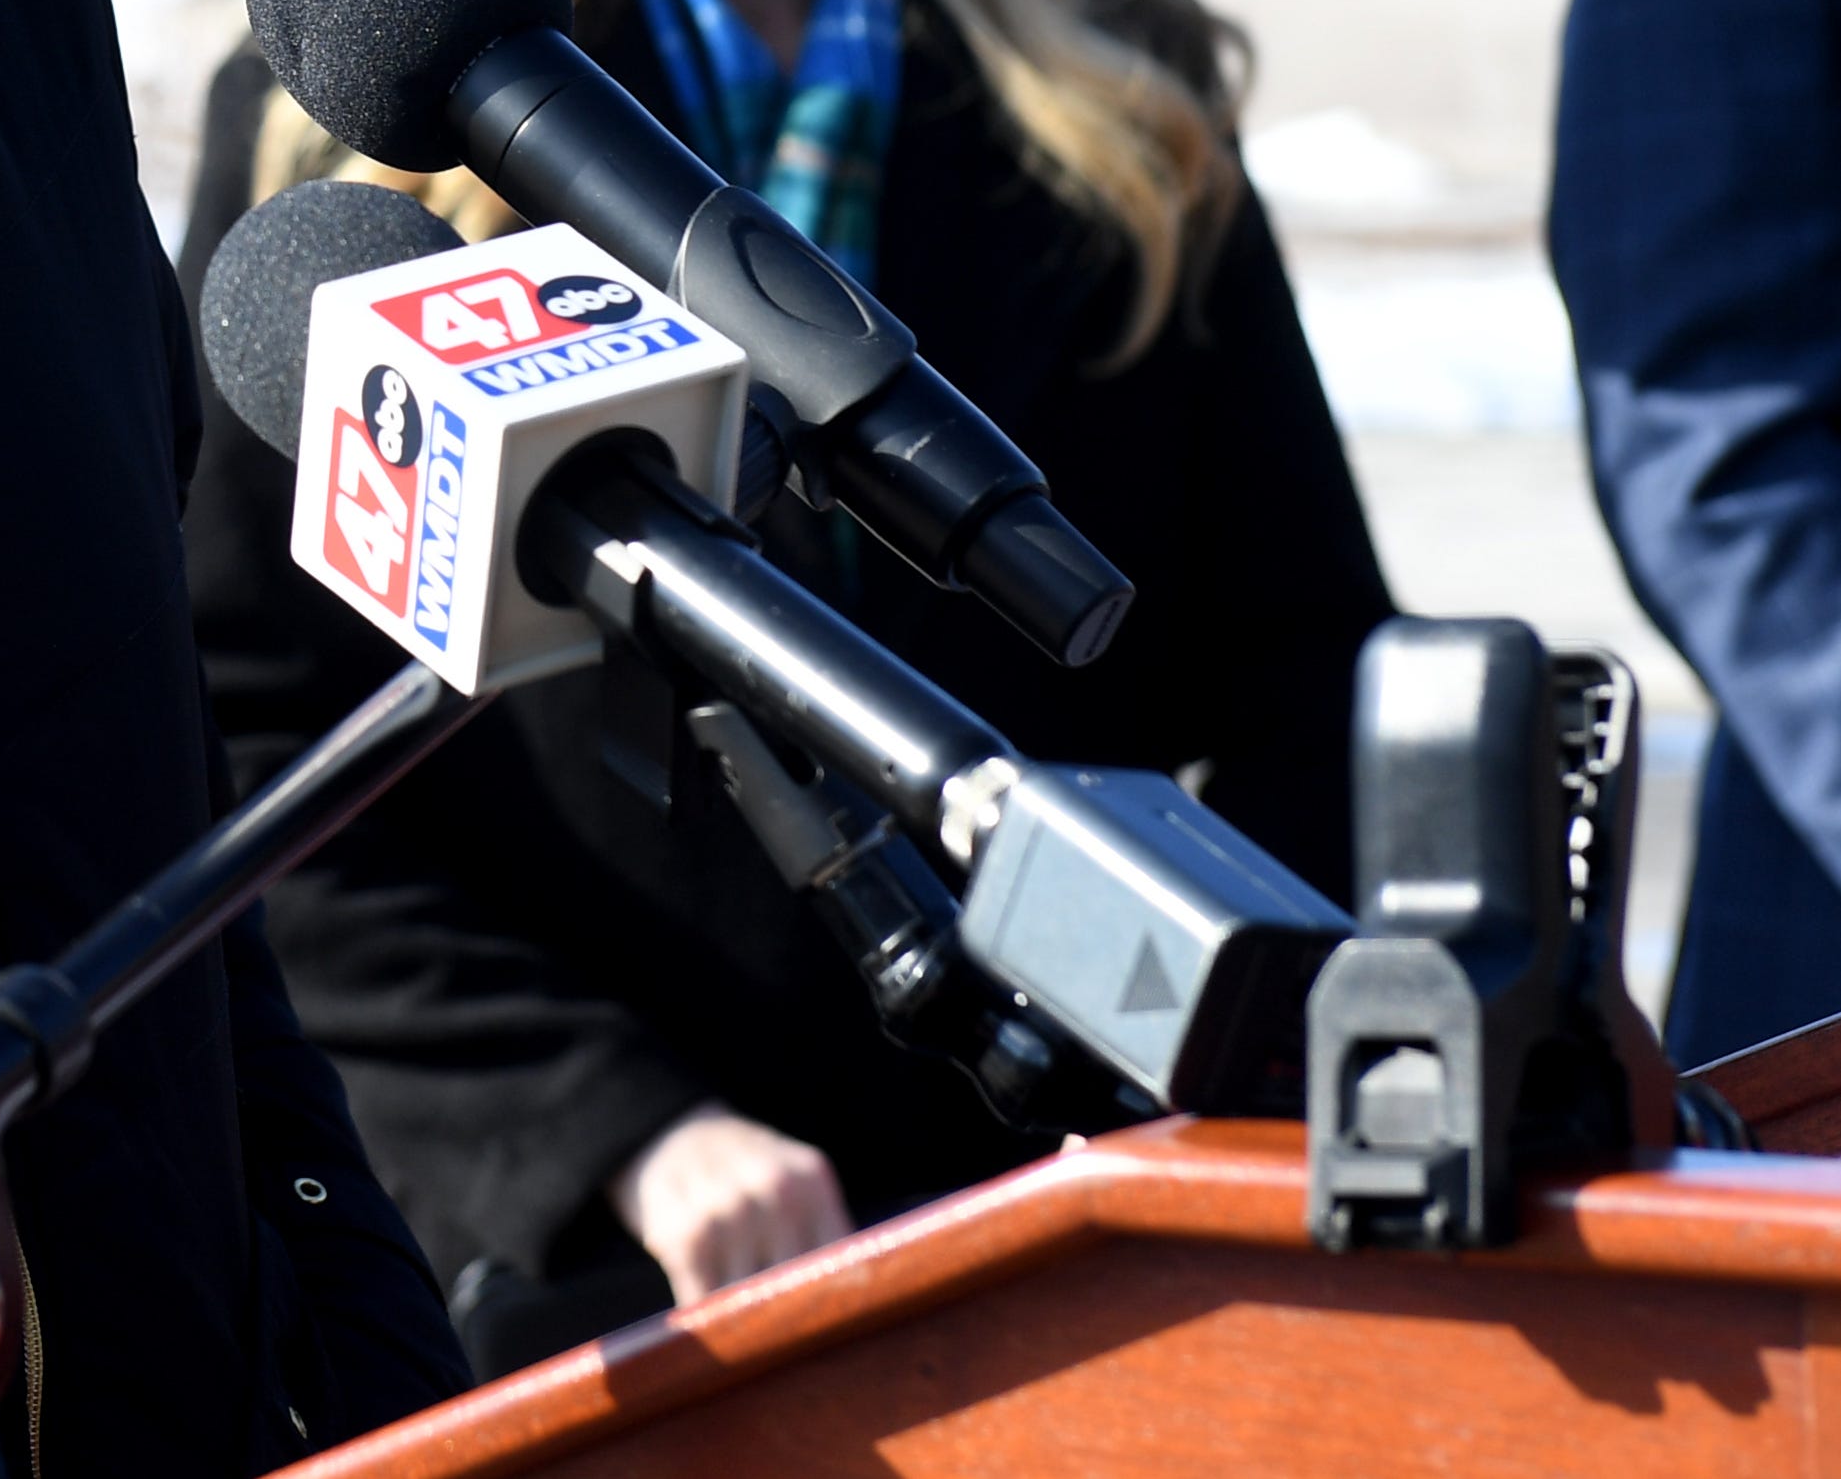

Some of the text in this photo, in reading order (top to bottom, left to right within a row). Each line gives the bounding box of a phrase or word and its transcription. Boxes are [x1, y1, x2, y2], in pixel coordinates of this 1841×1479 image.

[422, 276, 633, 351] 47 abc
[473, 321, 670, 392] WMDT
[334, 369, 409, 596] 47 abc
[415, 410, 465, 633] WMDT
